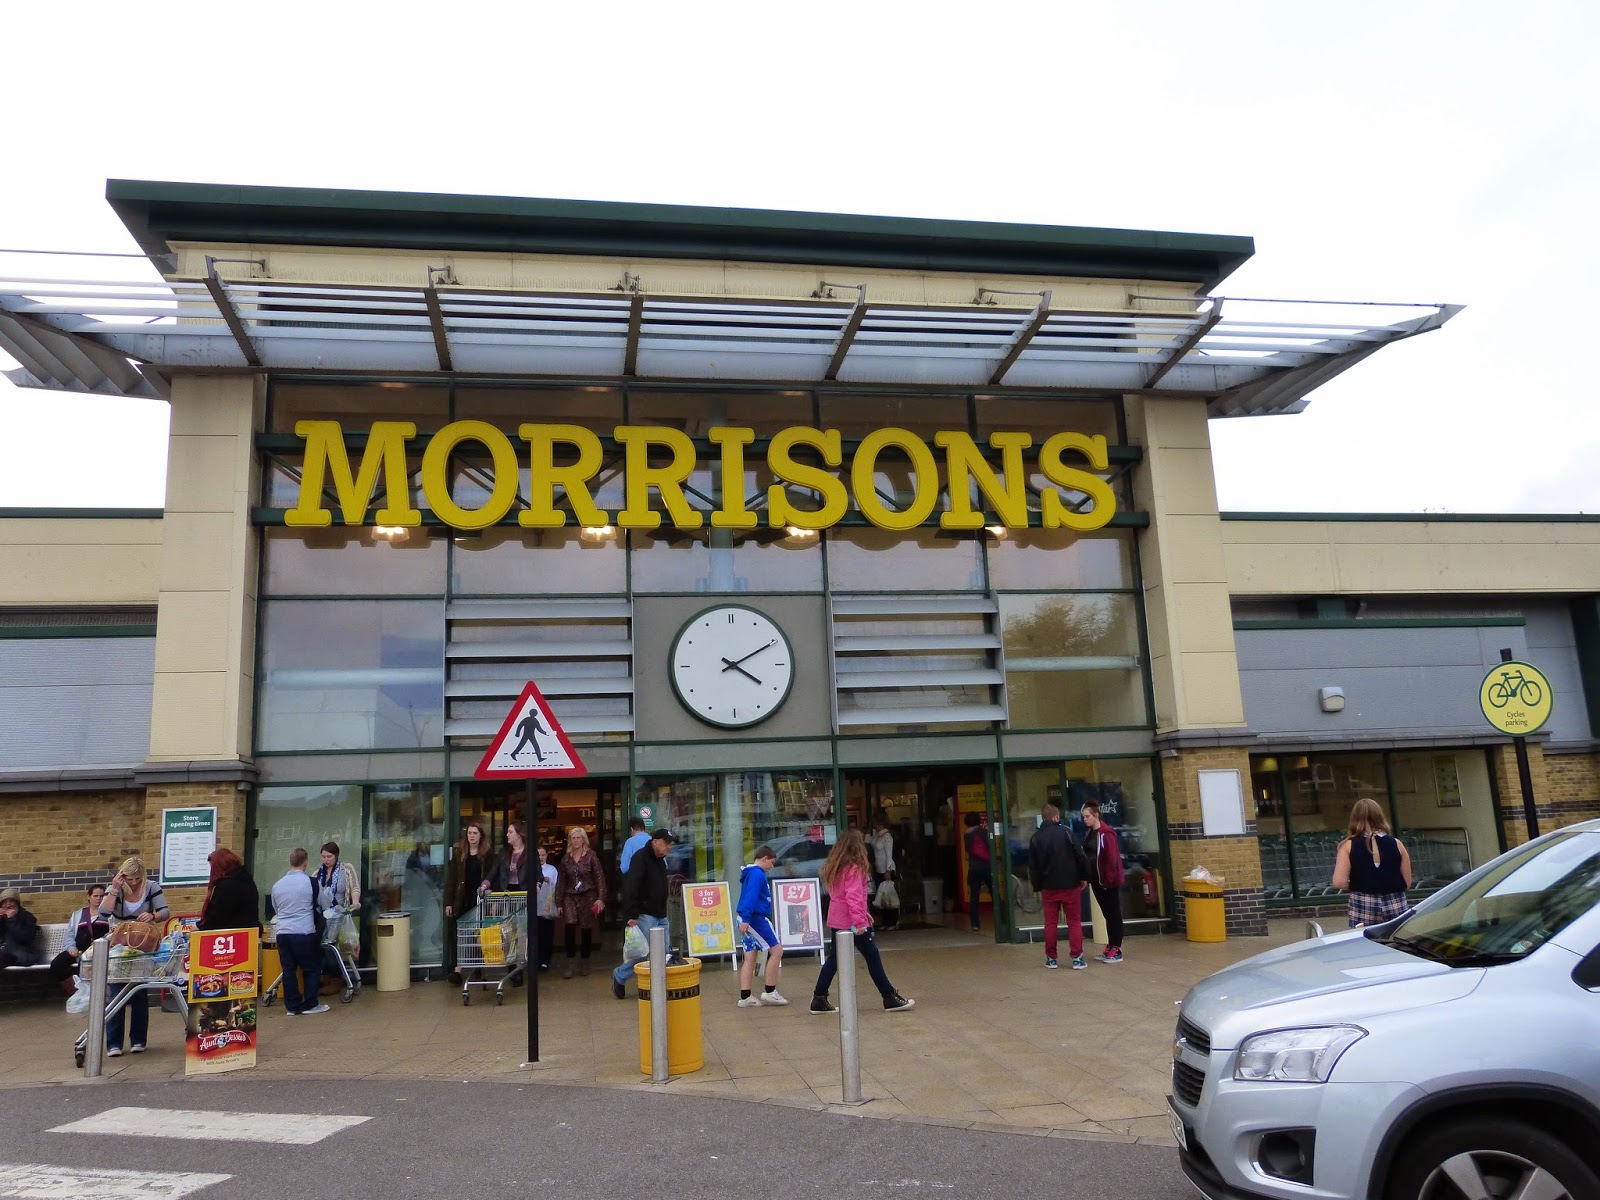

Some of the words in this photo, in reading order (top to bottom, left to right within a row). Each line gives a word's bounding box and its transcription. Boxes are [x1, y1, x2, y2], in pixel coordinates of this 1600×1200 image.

[285, 419, 1117, 531] MORRISONS
[1506, 711, 1525, 719] Cycles
[1505, 719, 1528, 727] parking
[704, 889, 714, 897] for
[787, 885, 807, 899] £7
[701, 897, 713, 905] £5
[212, 935, 236, 955] £1
[200, 1036, 218, 1051] Aunt
